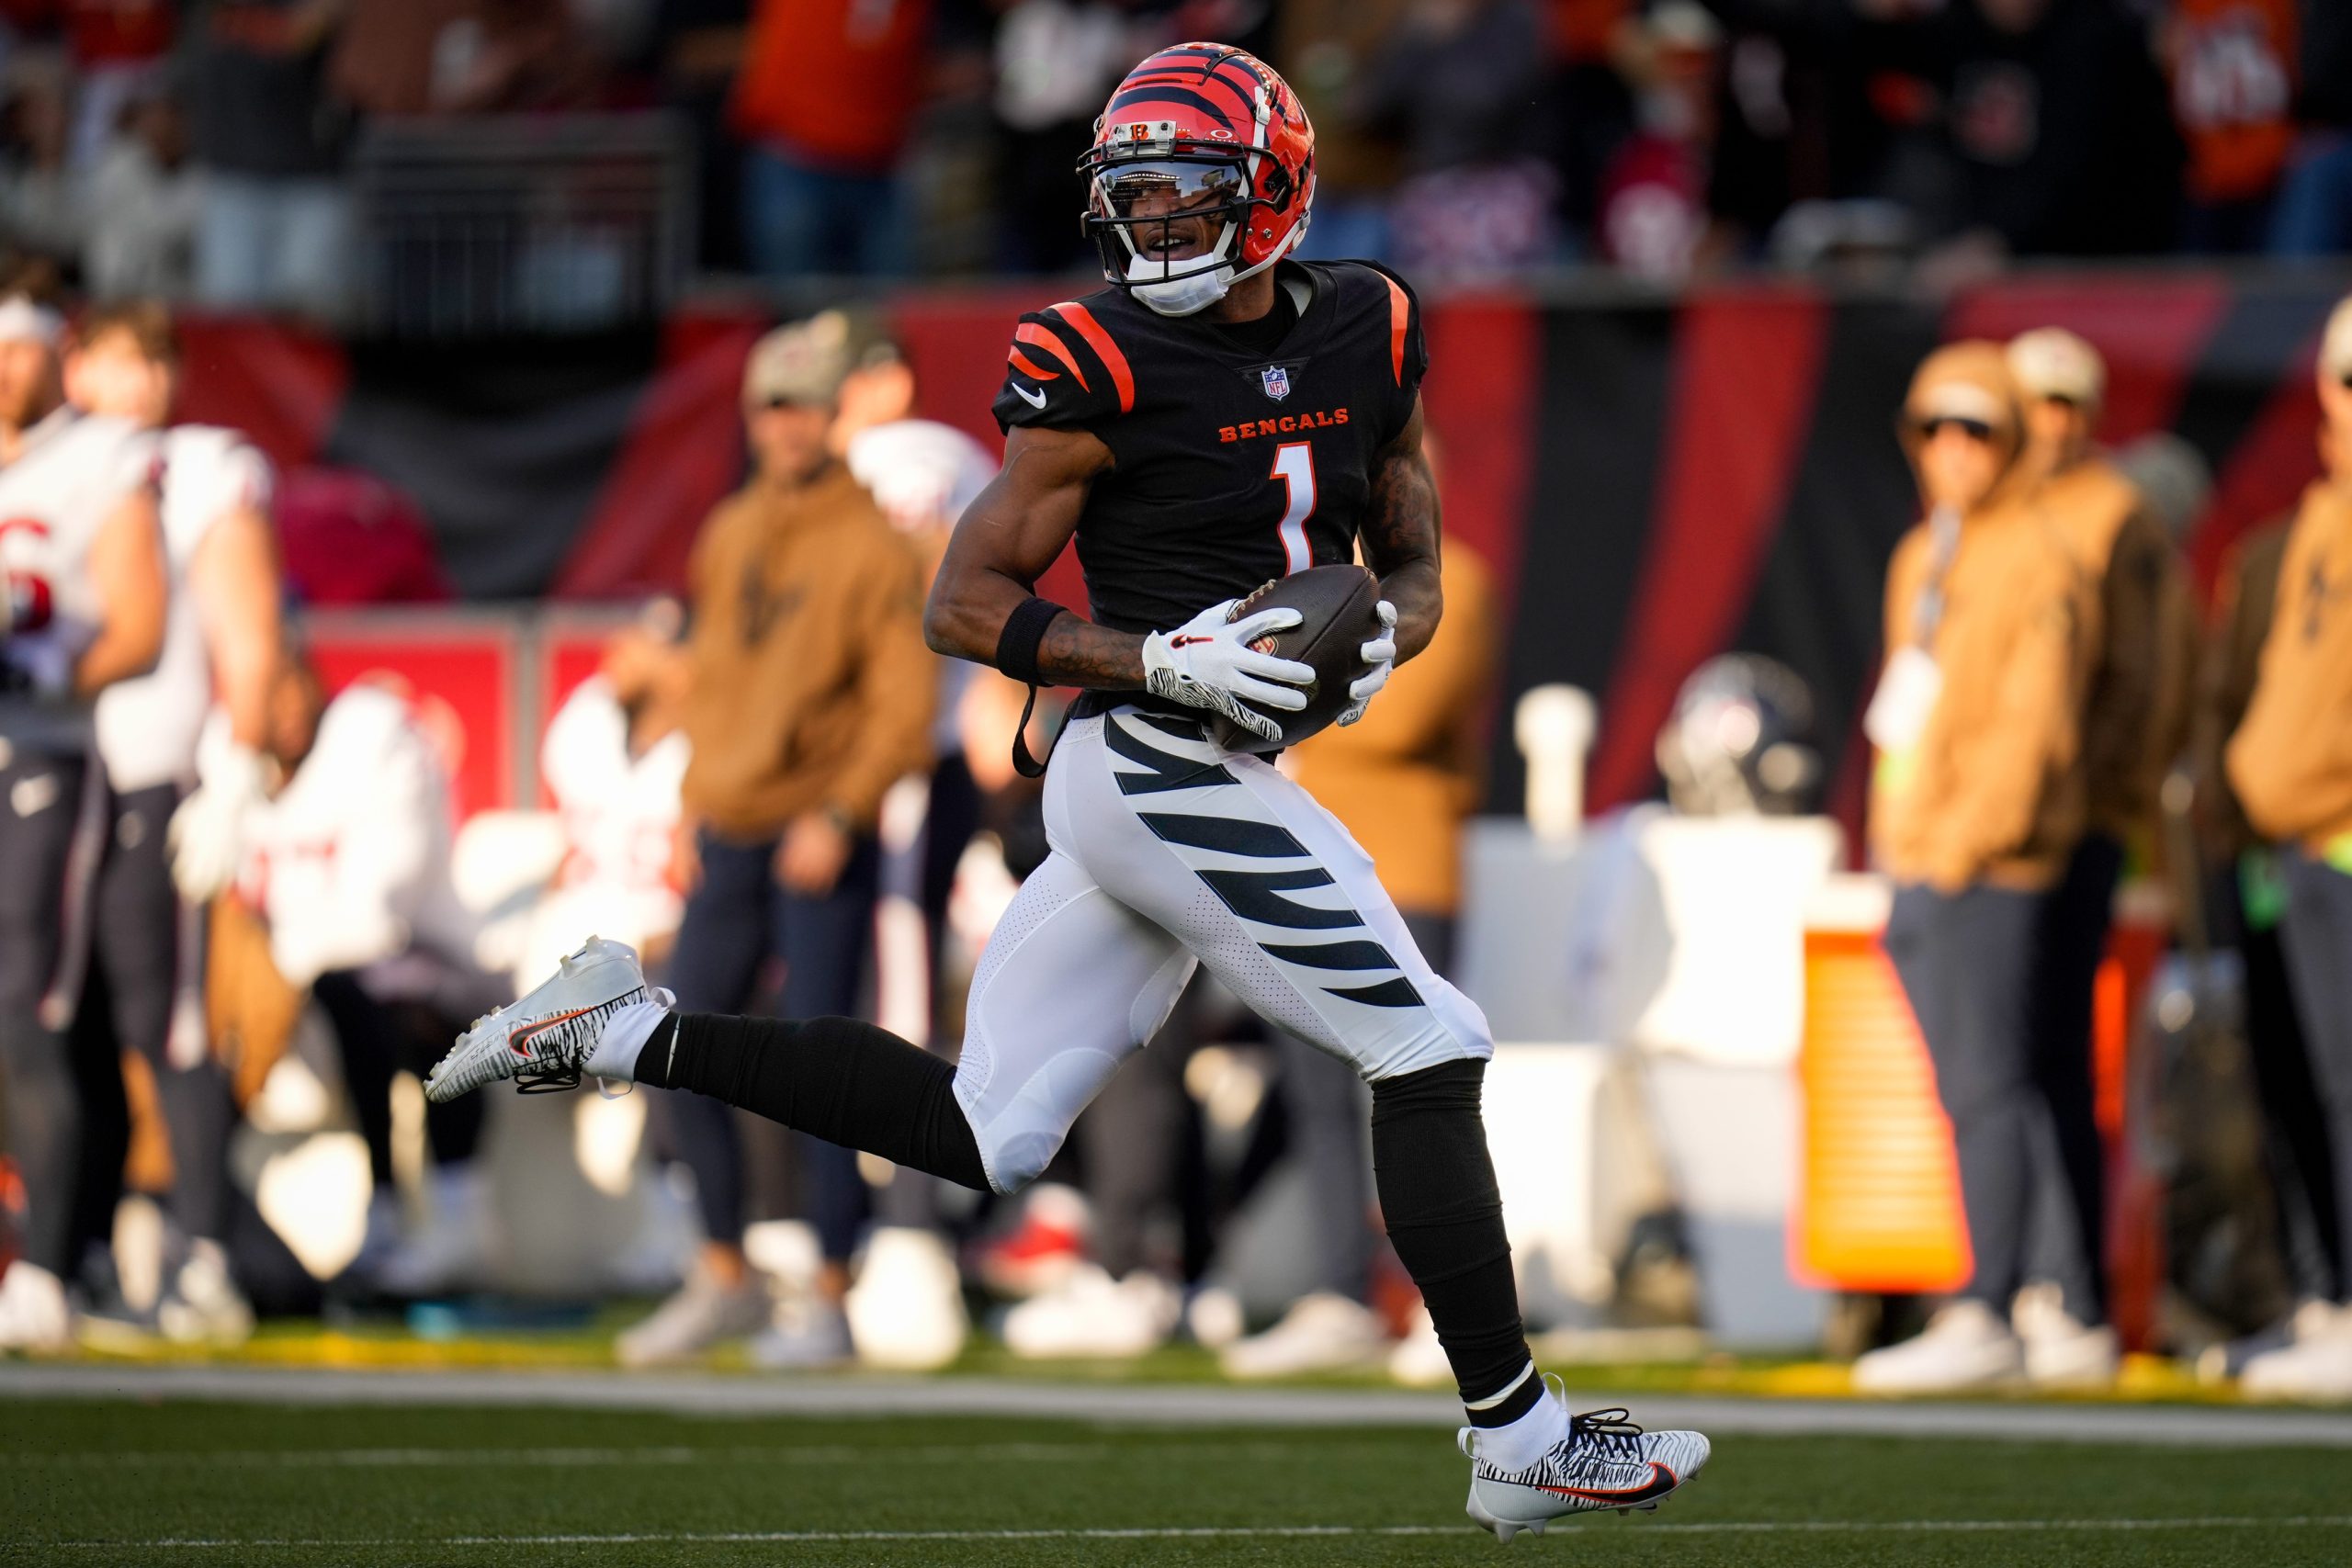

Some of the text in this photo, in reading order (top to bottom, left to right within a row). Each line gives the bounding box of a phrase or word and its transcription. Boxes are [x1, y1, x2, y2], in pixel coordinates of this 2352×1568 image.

[1268, 381, 1286, 395] NFL
[1218, 408, 1349, 443] BENGALS
[1270, 440, 1317, 578] 1
